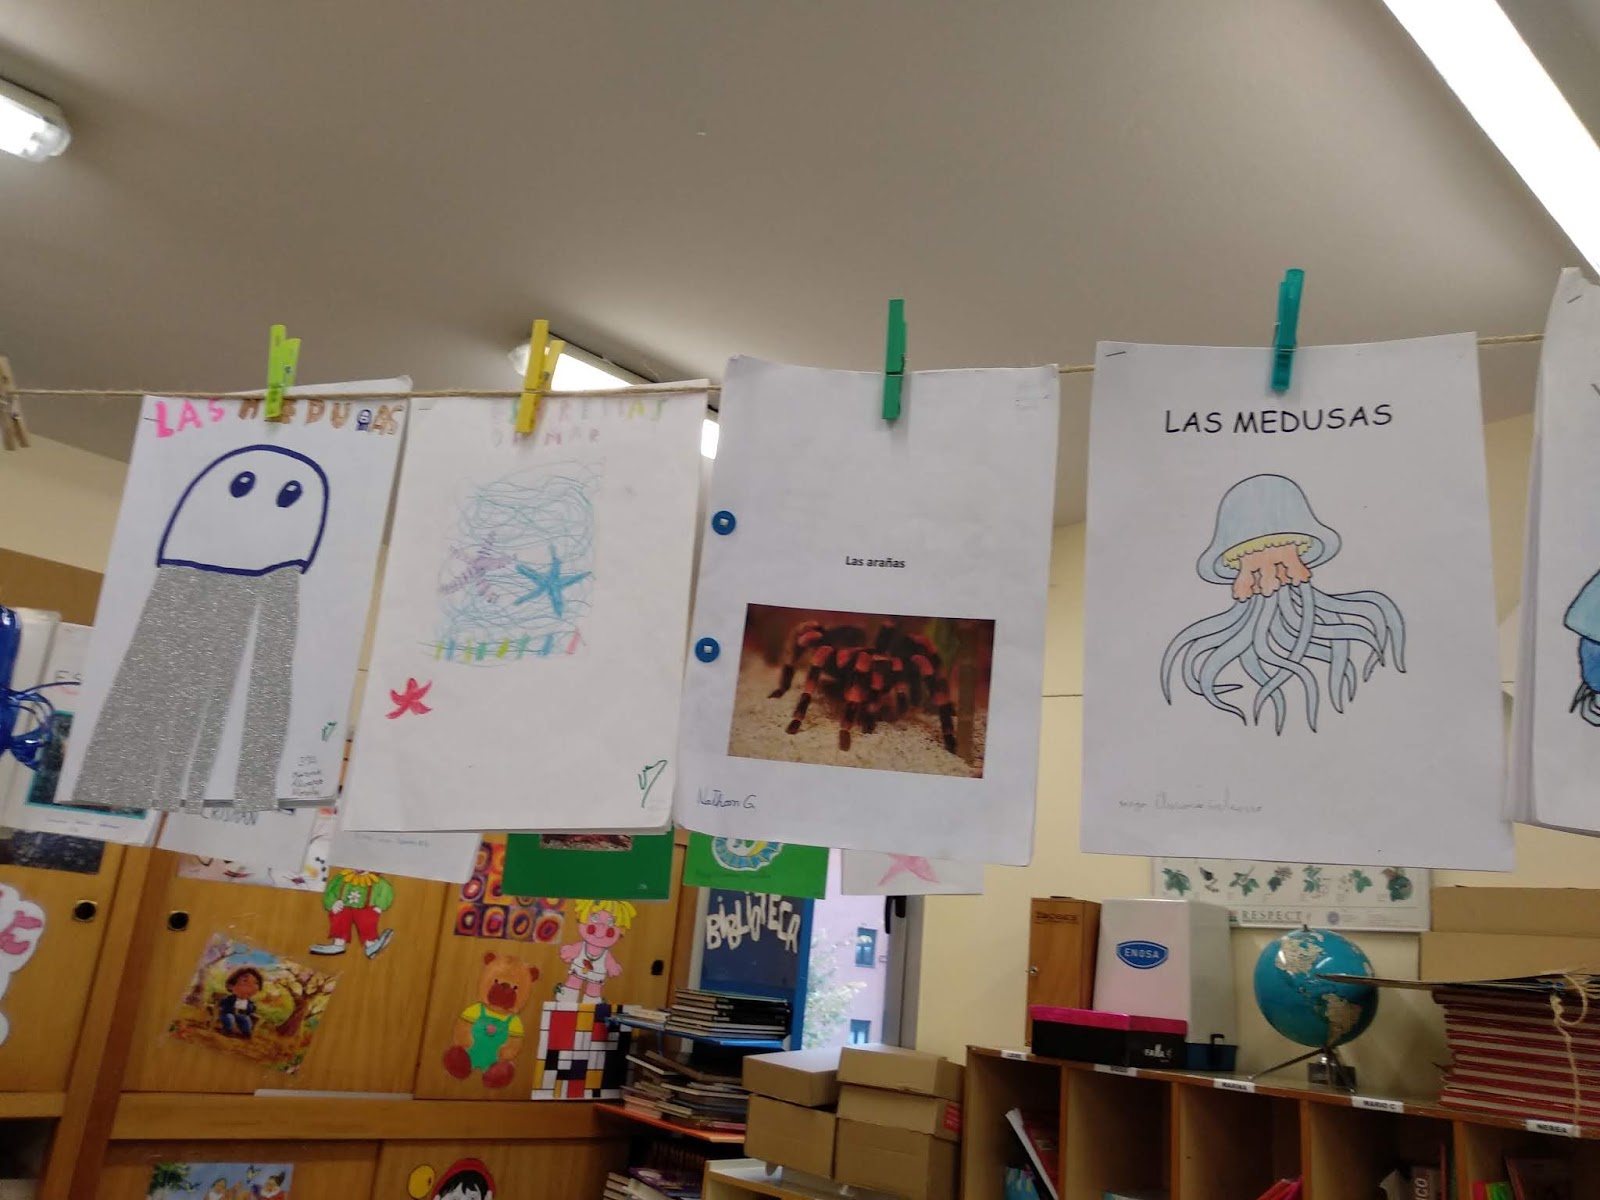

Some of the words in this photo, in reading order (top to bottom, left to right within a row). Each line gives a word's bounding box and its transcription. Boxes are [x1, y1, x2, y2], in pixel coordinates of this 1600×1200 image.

[155, 398, 224, 437] LAS
[1165, 410, 1222, 433] LAS
[1233, 404, 1393, 433] MEDUSAS
[845, 555, 864, 567] Las
[866, 557, 906, 569] arañas
[1124, 947, 1160, 959] ENOSA
